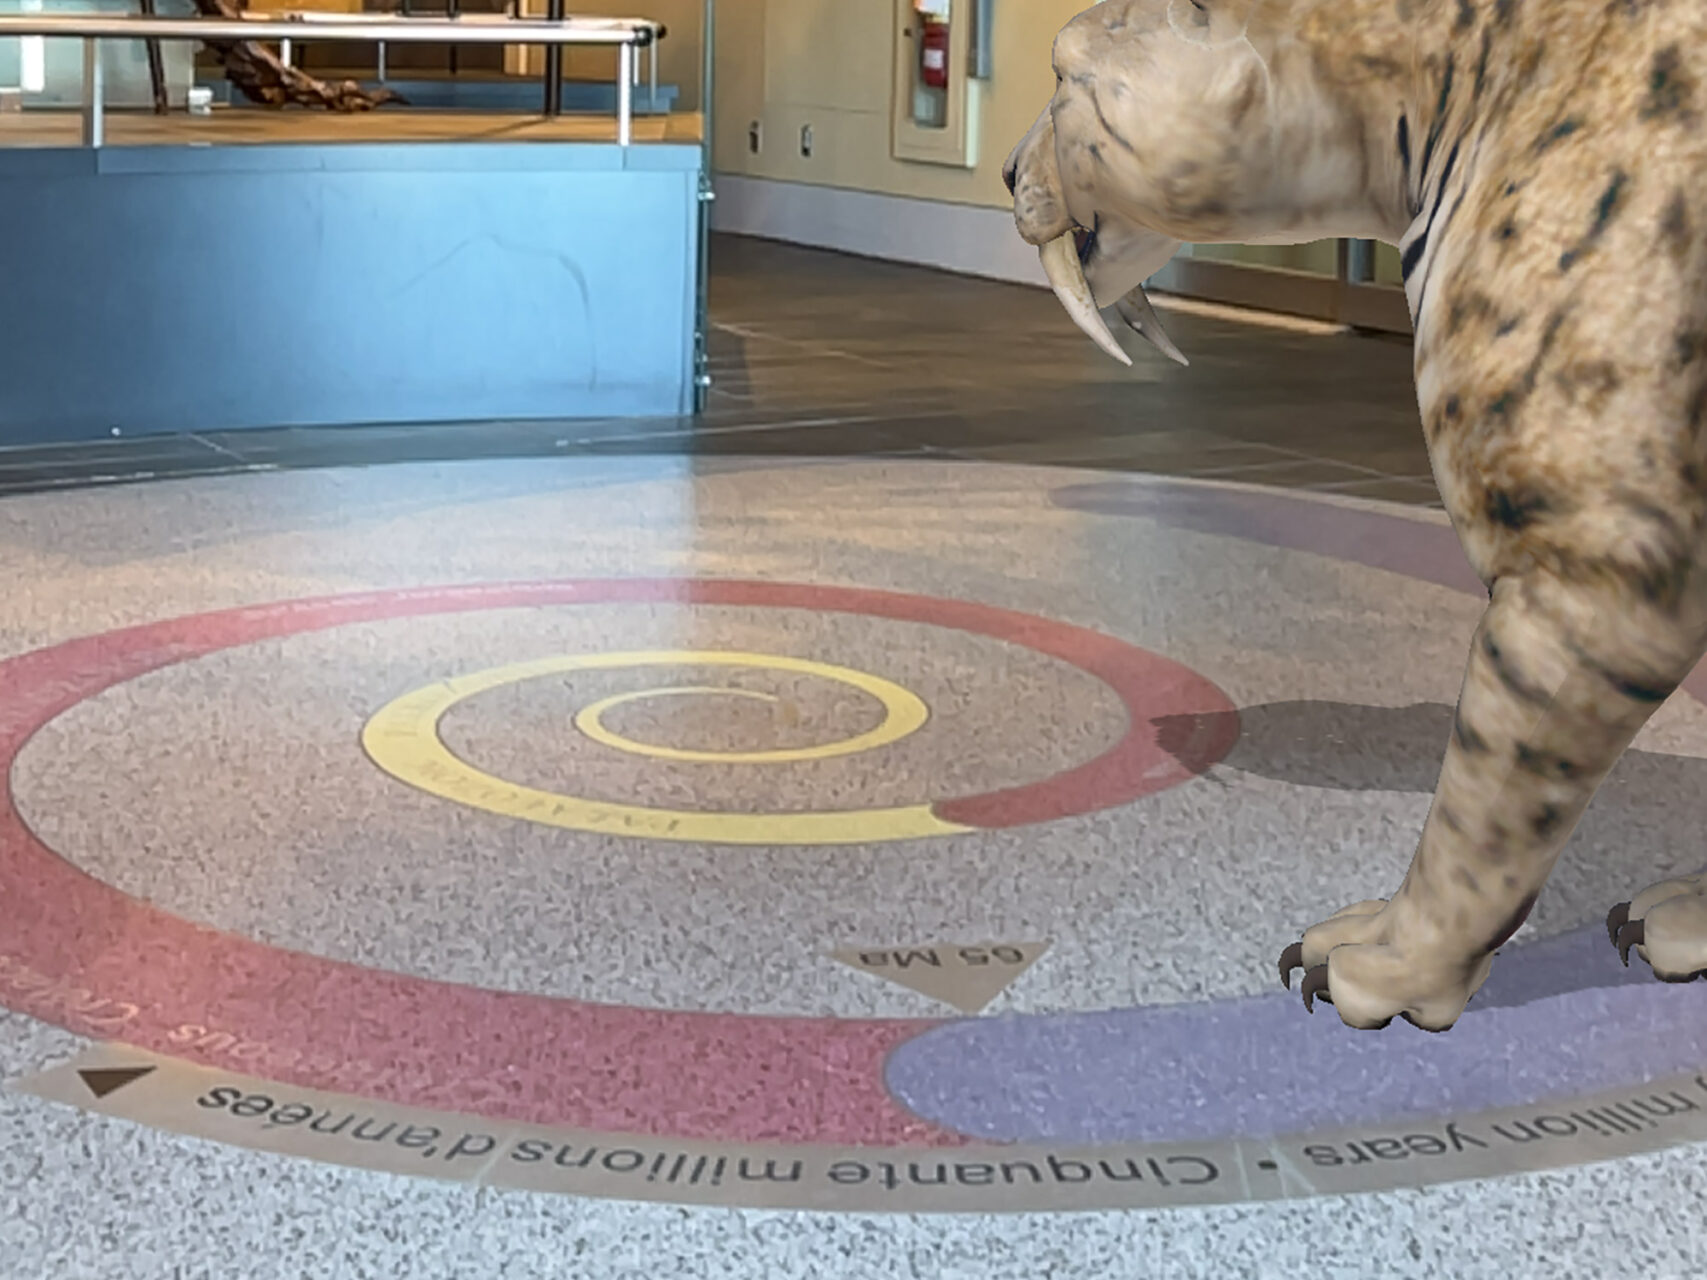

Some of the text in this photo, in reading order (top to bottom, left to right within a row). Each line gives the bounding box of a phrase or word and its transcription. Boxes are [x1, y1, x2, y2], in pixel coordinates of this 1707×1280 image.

[197, 1086, 1700, 1191] million years Cinquante millions d'années
